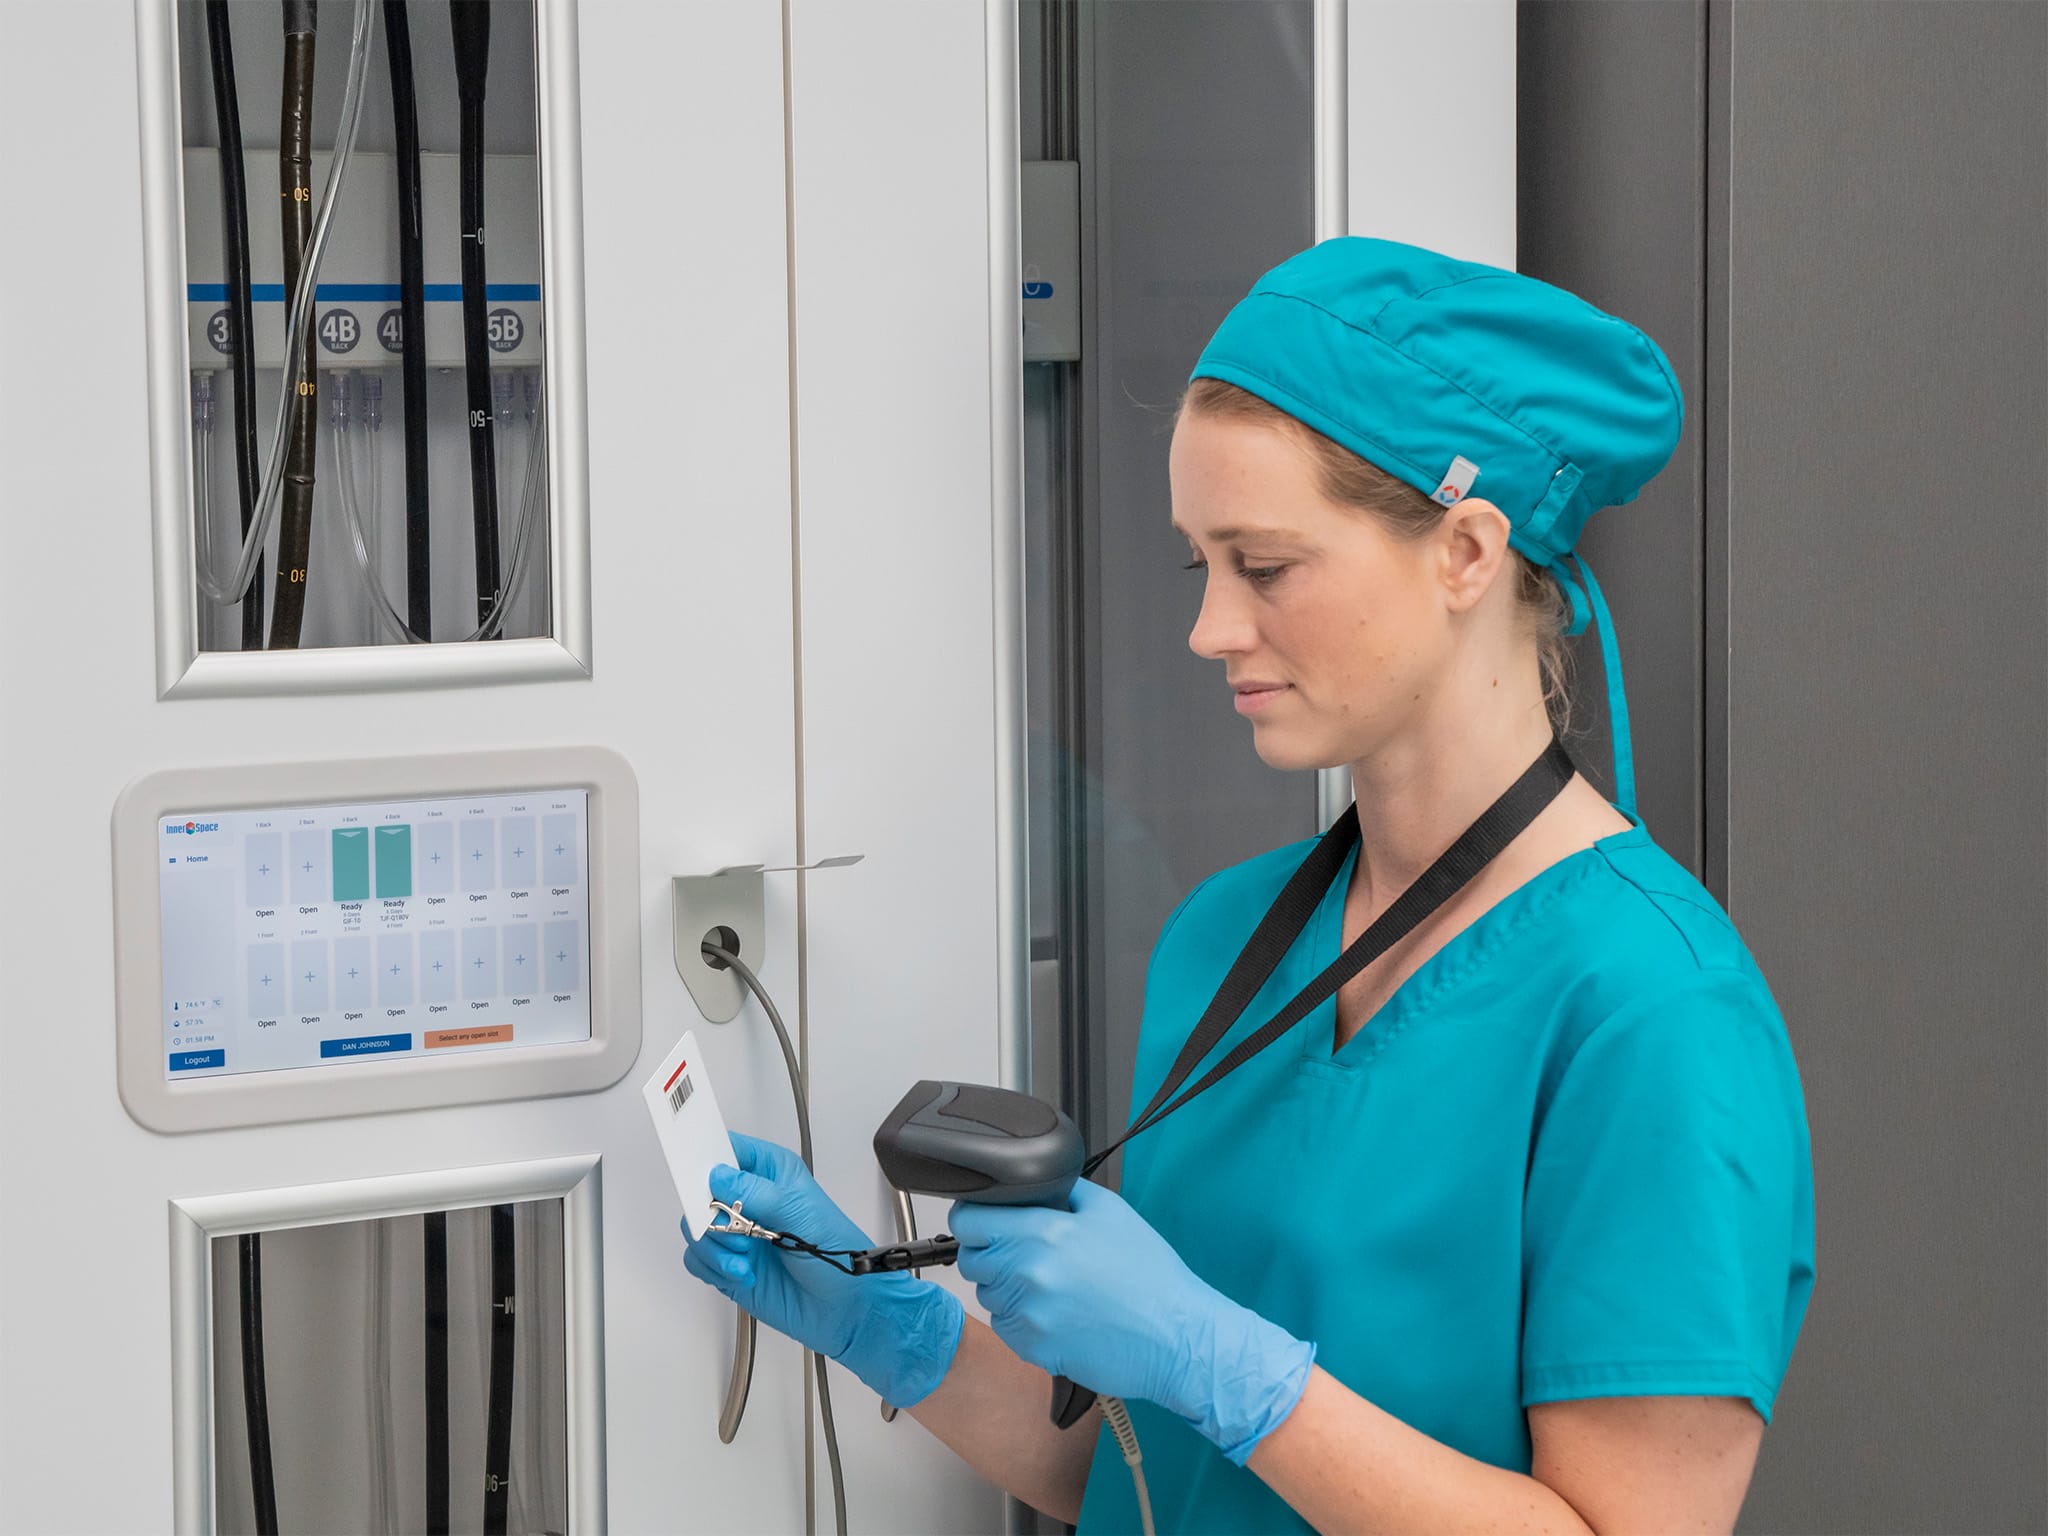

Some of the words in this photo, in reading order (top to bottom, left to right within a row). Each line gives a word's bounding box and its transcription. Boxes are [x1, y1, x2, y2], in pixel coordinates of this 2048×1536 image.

[213, 316, 232, 343] 3
[322, 316, 355, 342] 4B
[488, 315, 518, 341] 5B
[186, 855, 208, 863] Home
[510, 891, 528, 900] Open
[552, 888, 570, 896] Open
[428, 897, 446, 906] Open
[469, 894, 487, 903] Open
[341, 902, 362, 911] Ready
[384, 900, 405, 908] Ready
[256, 909, 275, 918] Open
[299, 906, 318, 915] Open
[512, 998, 530, 1006] Open
[553, 994, 571, 1002] Open
[429, 1005, 447, 1013] Open
[471, 1002, 489, 1010] Open
[344, 1012, 363, 1021] Open
[387, 1008, 405, 1017] Open
[258, 1020, 276, 1029] Open
[301, 1016, 320, 1024] Open
[471, 1032, 485, 1040] open
[342, 1043, 357, 1051] DAN
[358, 1040, 390, 1049] JOHNSON
[184, 1056, 210, 1065] Logout
